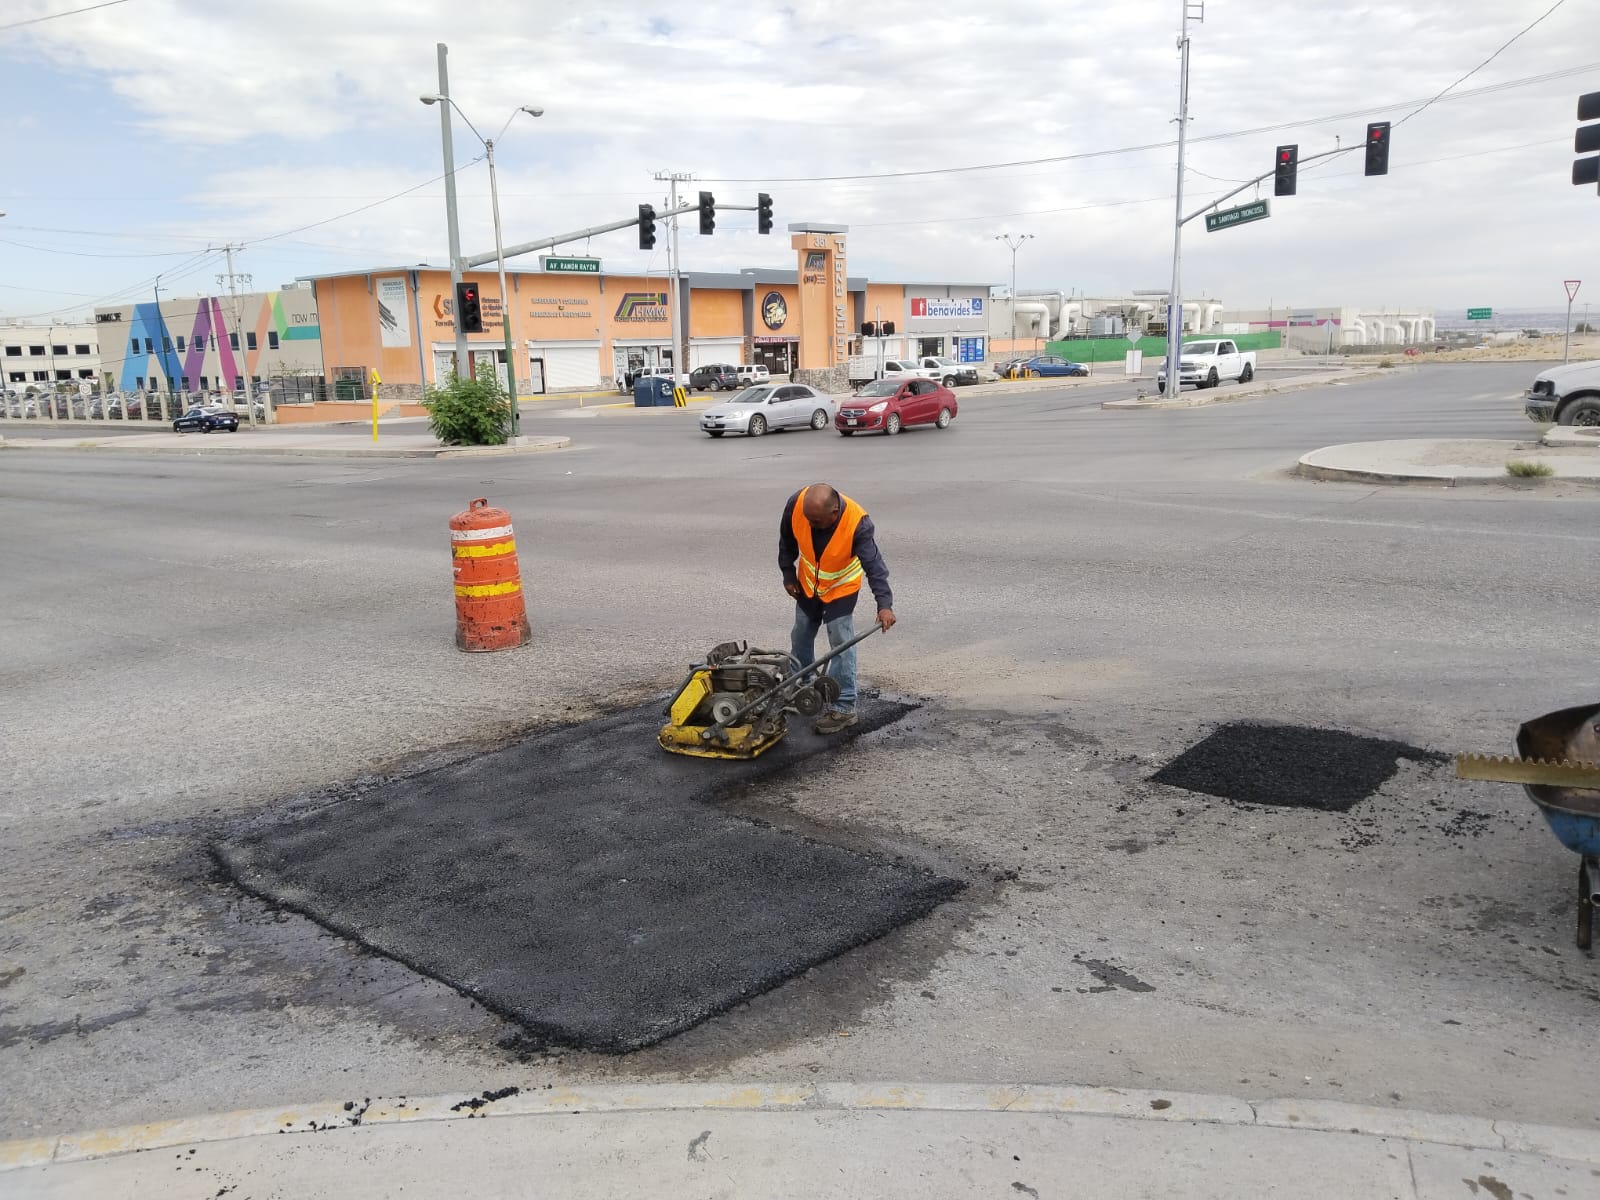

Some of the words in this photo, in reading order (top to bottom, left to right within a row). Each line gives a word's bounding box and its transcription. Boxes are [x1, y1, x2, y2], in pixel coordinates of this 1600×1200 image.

[834, 239, 846, 297] Plaza
[928, 303, 970, 316] benavides
[291, 313, 308, 323] now
